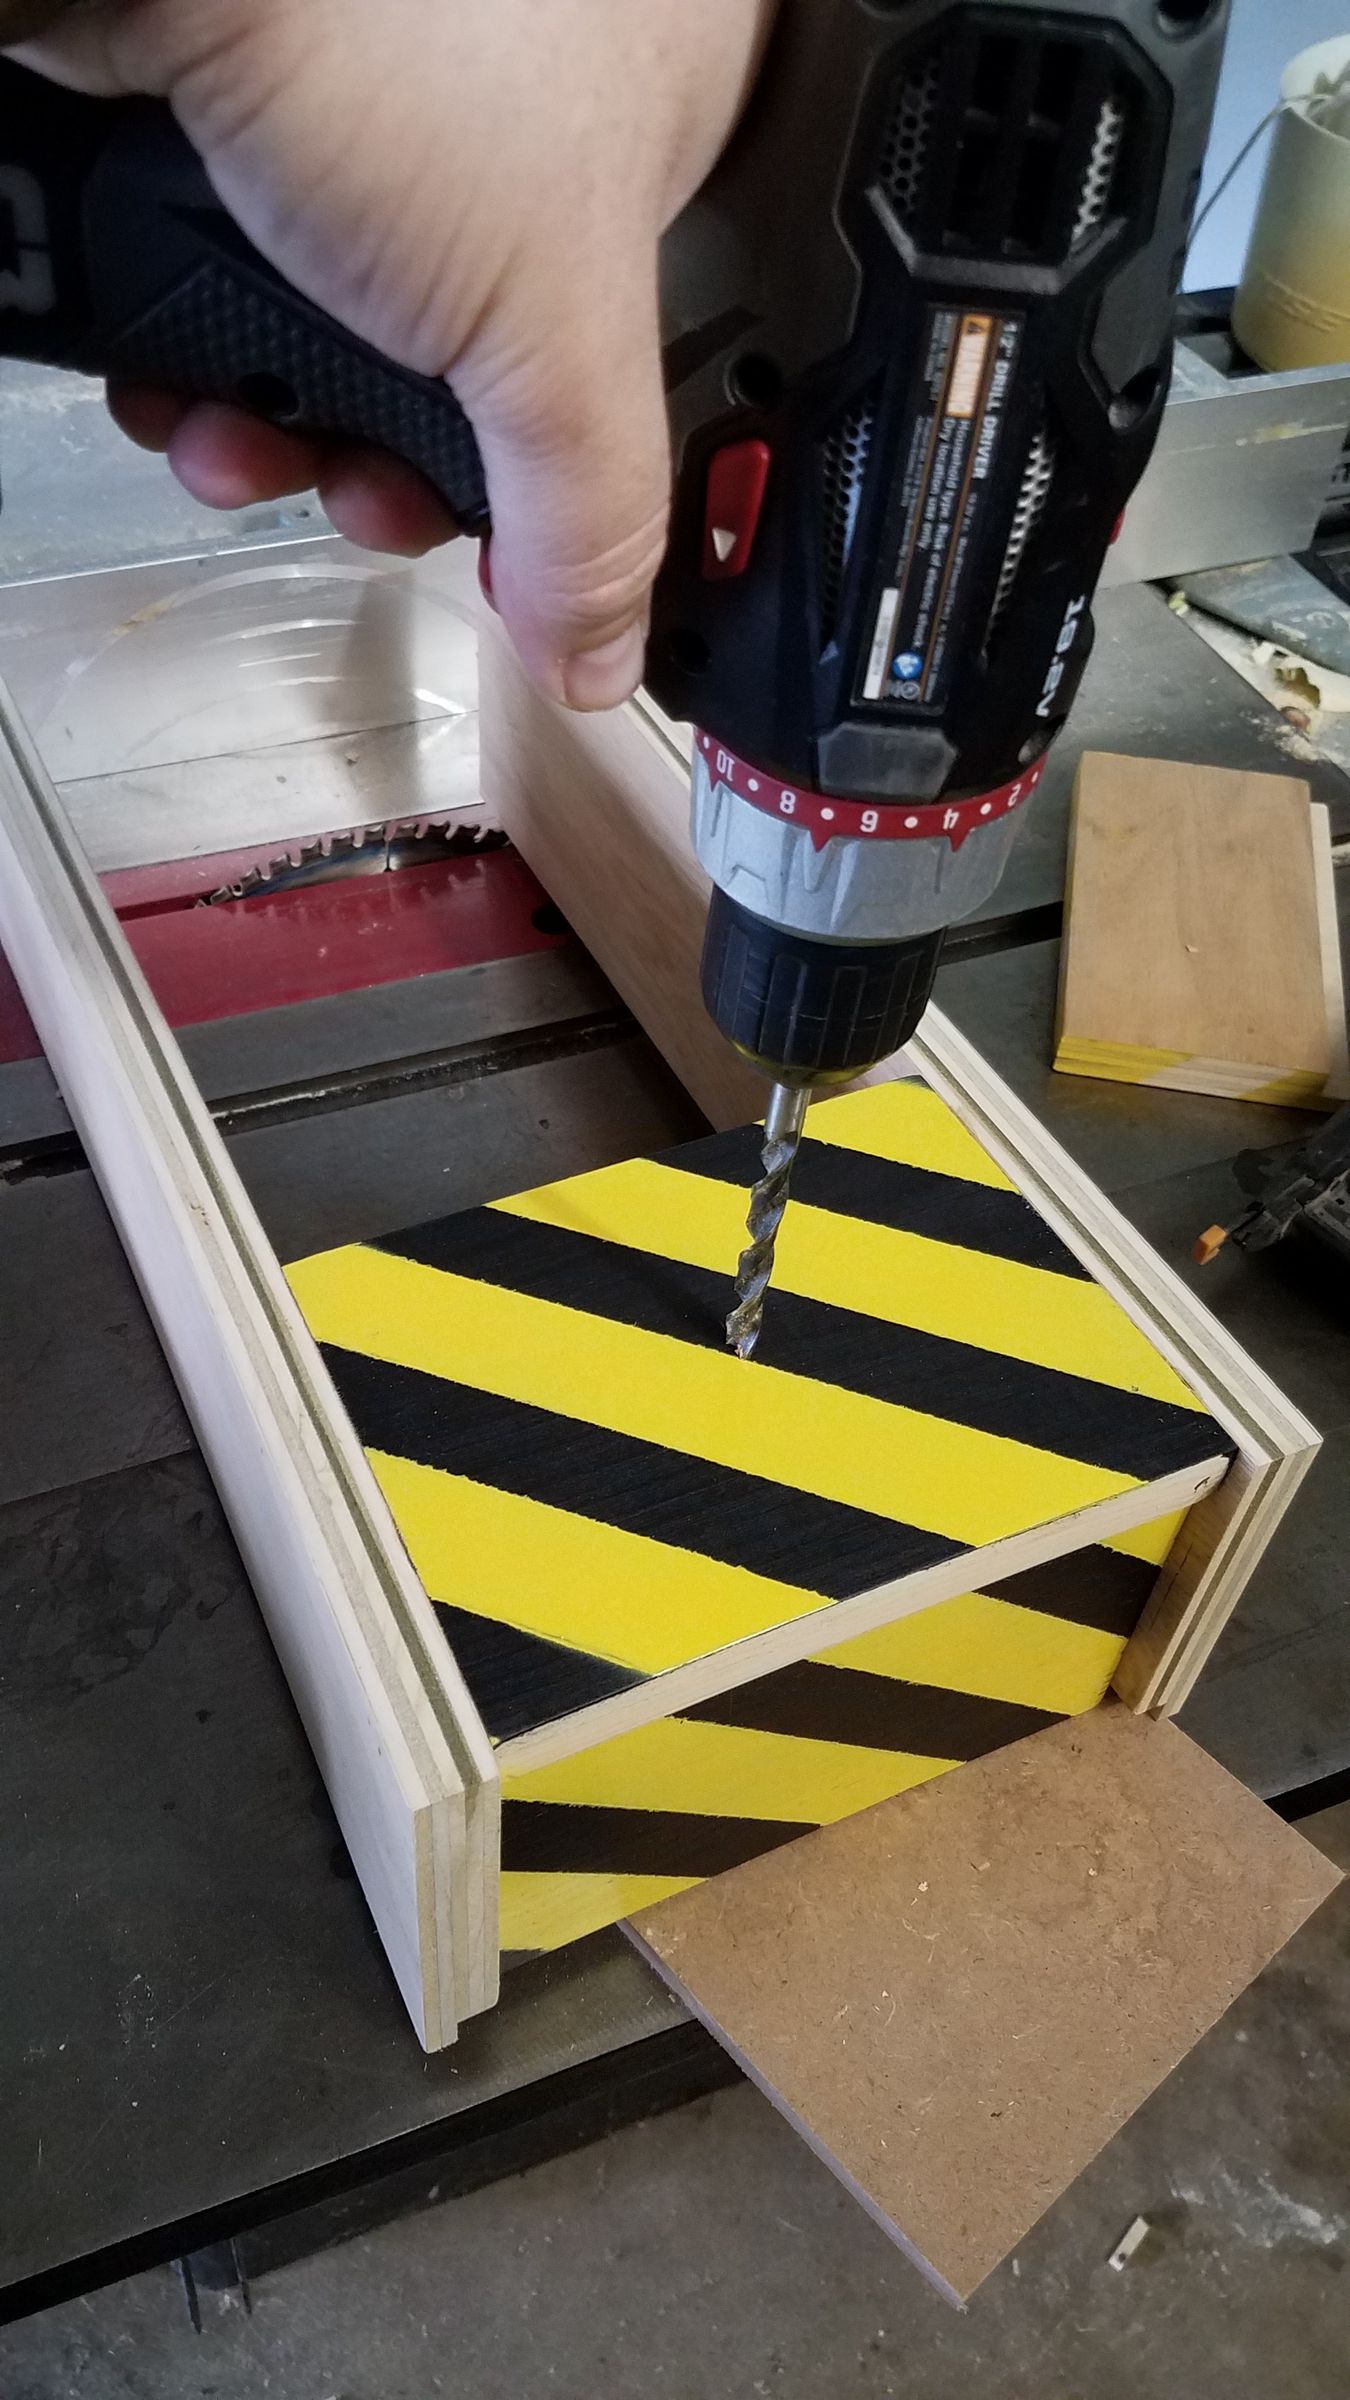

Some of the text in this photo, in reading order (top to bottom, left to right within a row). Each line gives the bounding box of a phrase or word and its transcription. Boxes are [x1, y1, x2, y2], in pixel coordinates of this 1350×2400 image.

[986, 360, 1010, 411] DRILL
[939, 418, 956, 442] Dry
[945, 419, 971, 489] Household
[972, 415, 999, 479] DRIVER
[929, 443, 950, 494] location
[716, 750, 1022, 833] 2 4 6 8 10
